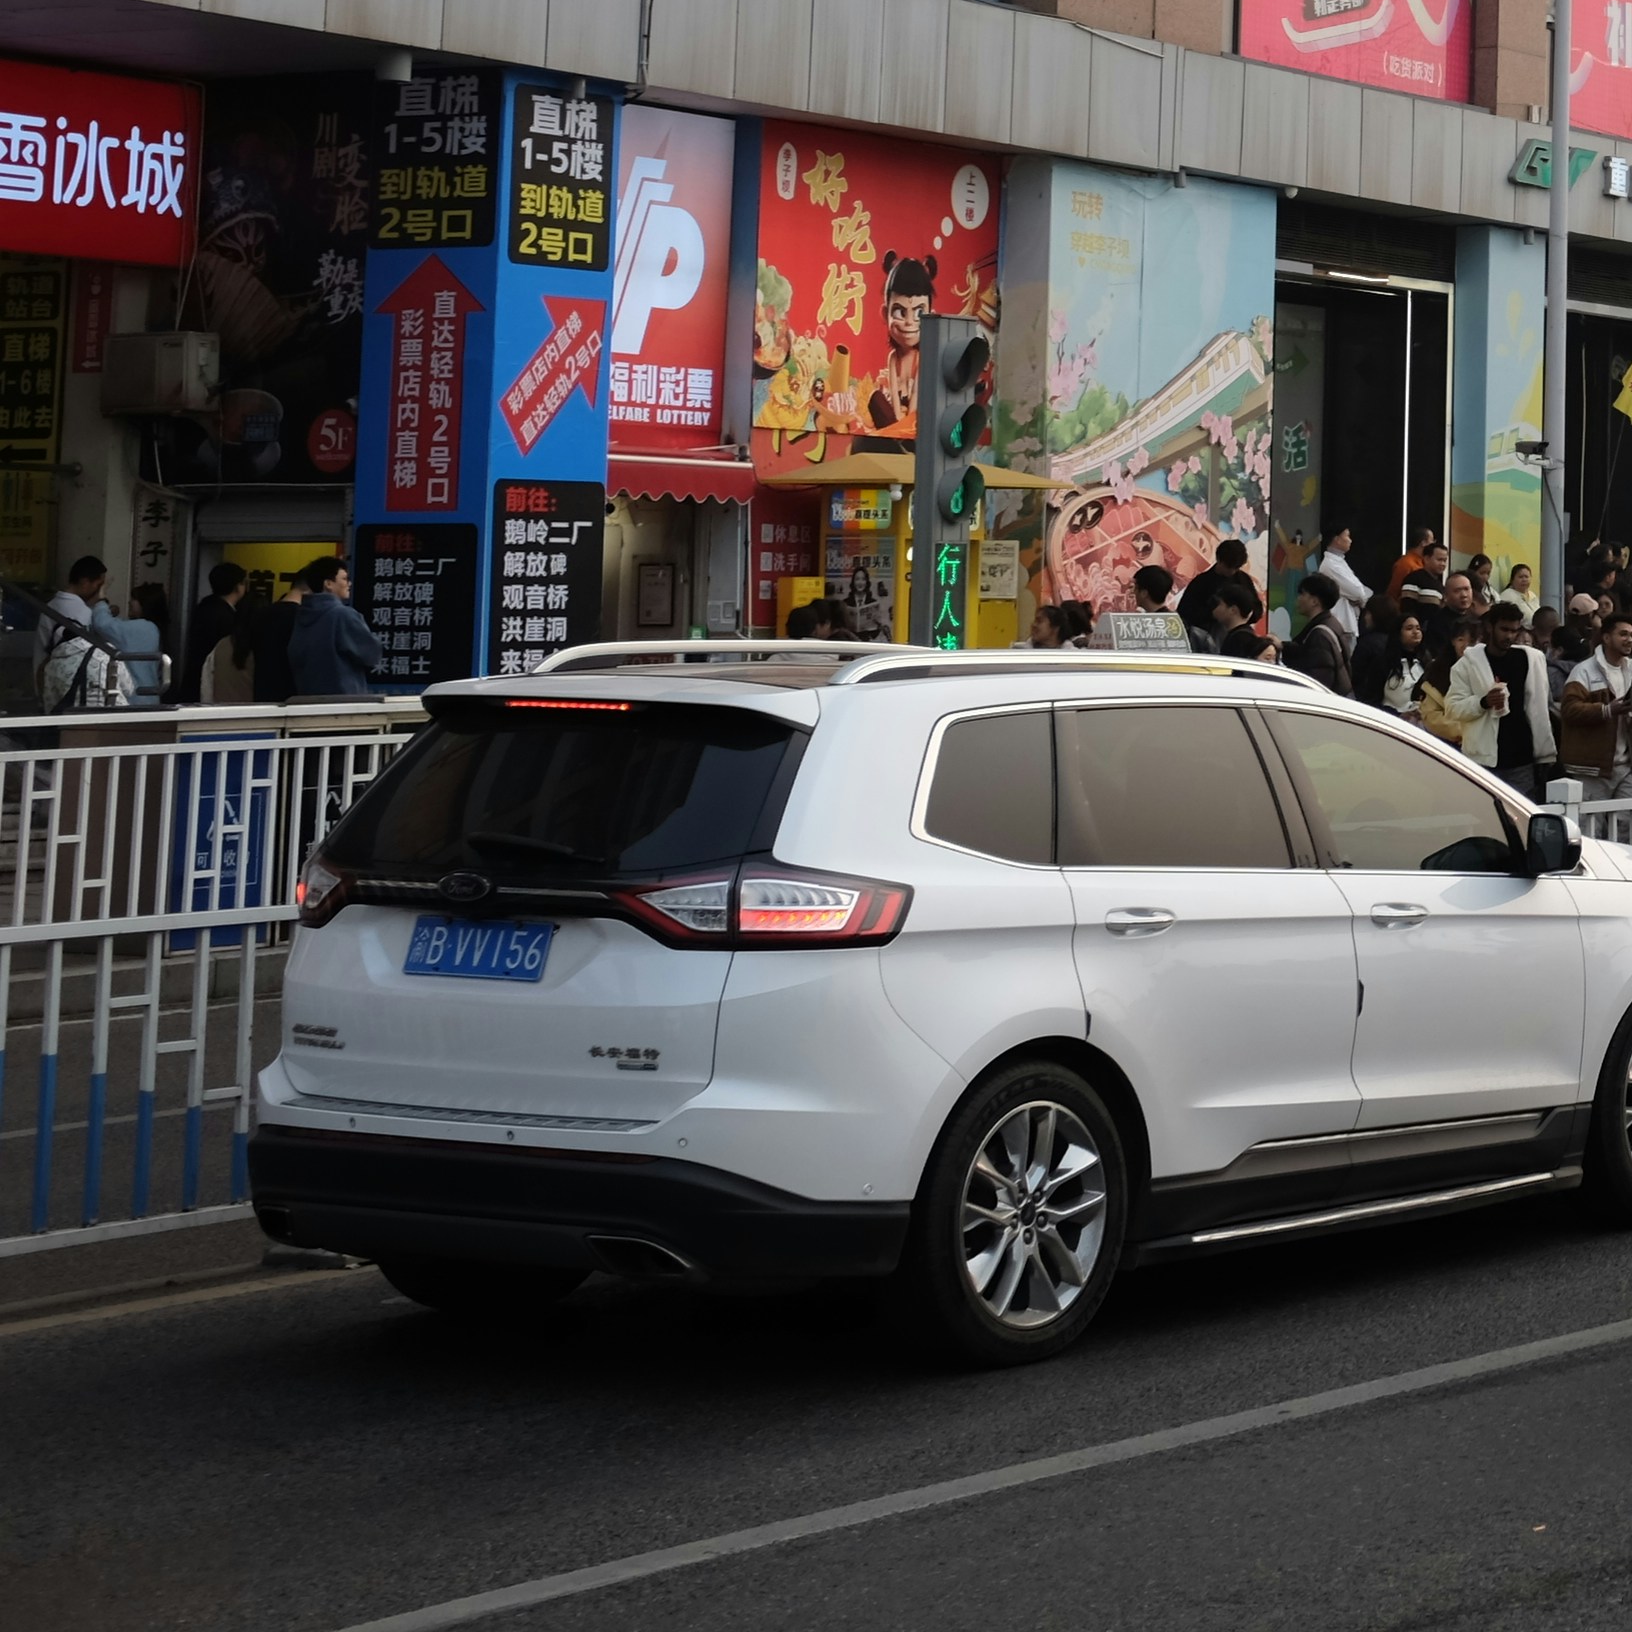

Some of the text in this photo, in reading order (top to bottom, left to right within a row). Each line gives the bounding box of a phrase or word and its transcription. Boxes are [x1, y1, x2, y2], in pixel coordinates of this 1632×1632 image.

[395, 76, 480, 118] 直梯
[528, 93, 598, 141] 直梯
[384, 116, 488, 156] 1-5楼
[0, 112, 184, 219] 雪冰城
[520, 137, 604, 183] 1-5楼
[330, 132, 369, 236] 变脸
[378, 164, 489, 200] 到轨道
[519, 183, 605, 225] 到轨道
[377, 208, 473, 240] 2号口
[518, 223, 593, 265] 2号口
[802, 149, 877, 336] 好吃街
[2, 332, 51, 363] 直梯
[507, 309, 584, 415] 彩票店内直梯
[393, 290, 458, 505] 彩票店内直梯 直达轻轨2号口
[519, 329, 604, 447] 直达轻轨2号口
[608, 363, 713, 410] 福利彩票
[319, 417, 352, 452] 5F
[656, 409, 711, 426] LOTTERY
[1282, 421, 1309, 472] 活
[505, 486, 558, 513] 前往:
[374, 534, 423, 553] 前往:
[504, 519, 593, 546] 鹅岭二厂
[374, 557, 457, 577] 鹅岭二厂
[503, 550, 568, 578] 解放碑
[373, 581, 435, 605] 解放碑
[502, 584, 569, 610] 观音桥
[372, 606, 434, 627] 观音桥
[501, 616, 568, 643] 洪崖洞
[371, 655, 431, 676] 来福士
[500, 649, 560, 674] 来福
[588, 1045, 661, 1060] 长安福特
